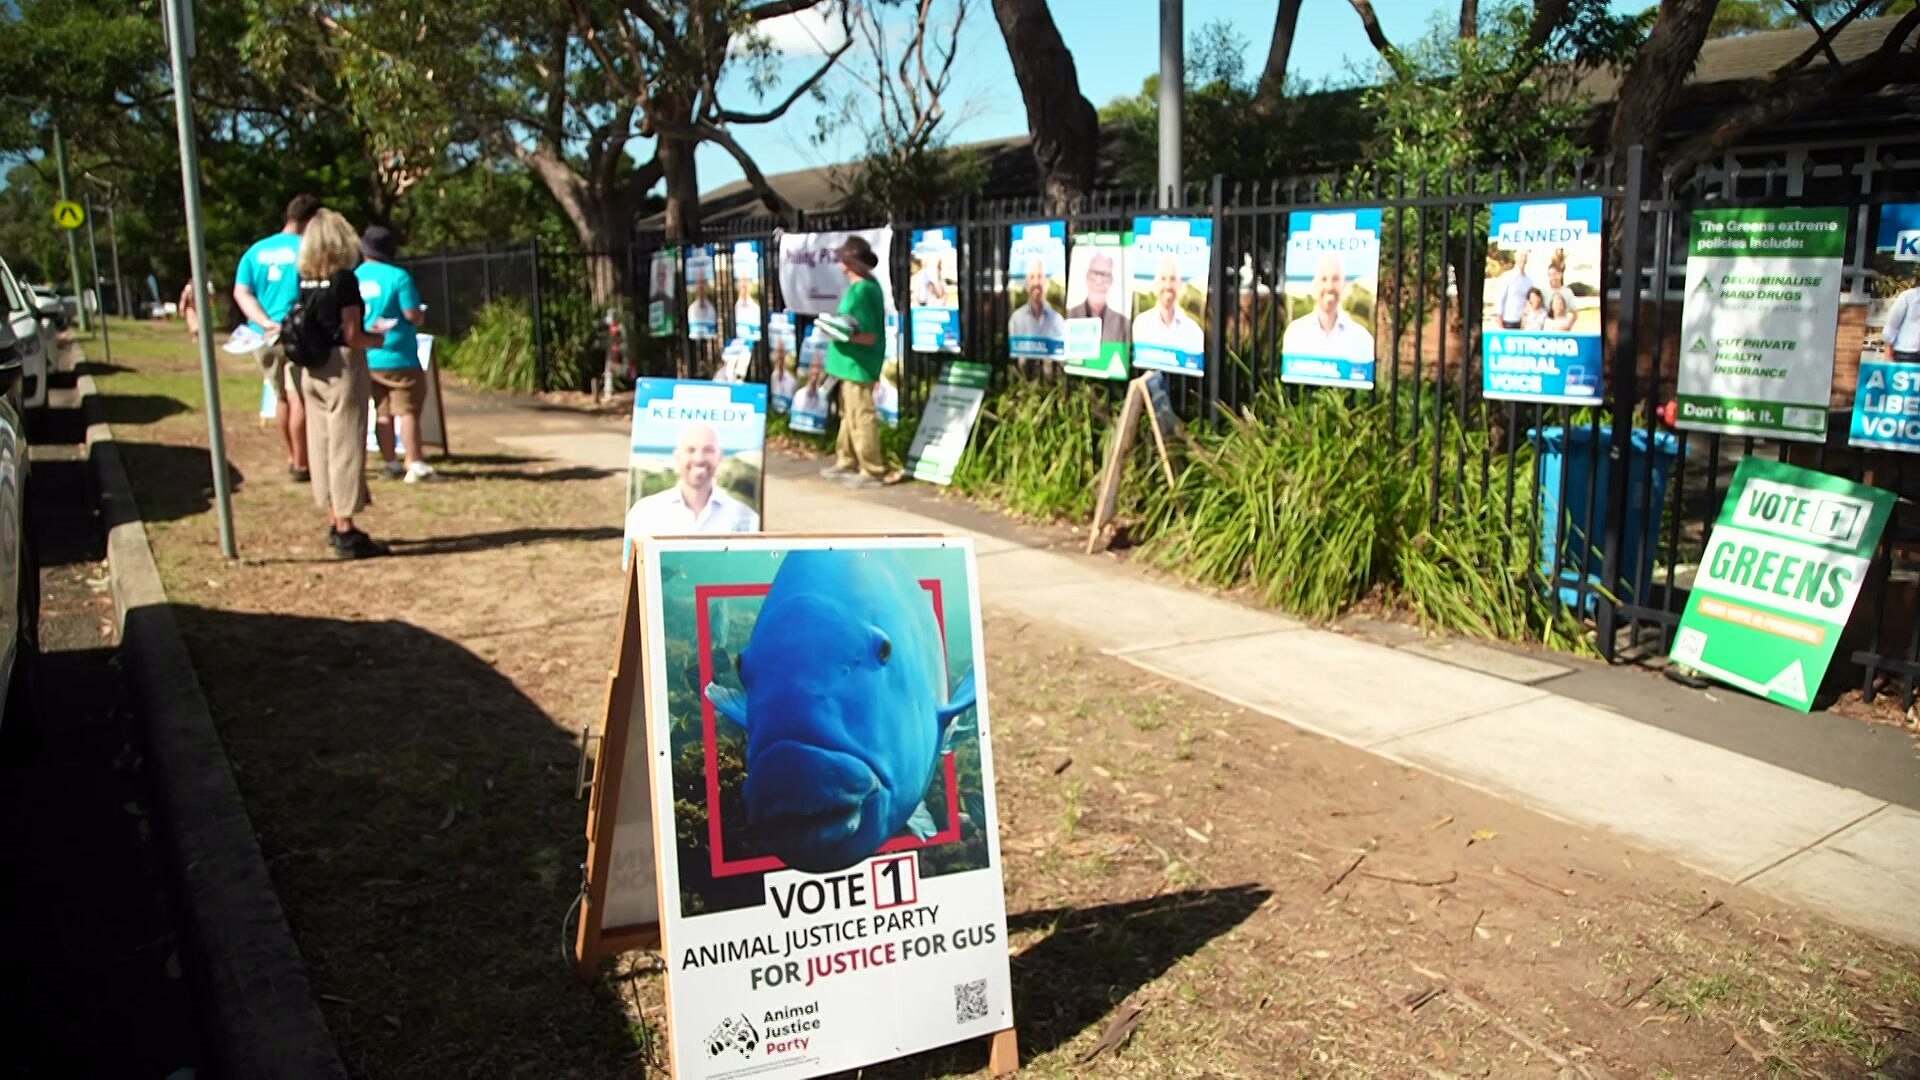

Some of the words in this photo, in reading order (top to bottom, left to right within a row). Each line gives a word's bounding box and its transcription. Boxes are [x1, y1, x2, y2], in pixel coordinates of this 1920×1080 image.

[1502, 227, 1583, 243] KENNEDY
[1699, 219, 1724, 233] The
[1726, 220, 1775, 233] Greens
[1778, 219, 1838, 232] extreme
[1295, 238, 1370, 251] KENNEDY
[1697, 236, 1747, 250] policies
[1749, 237, 1804, 249] include:
[1720, 274, 1822, 287] DECRIMINALISE
[1720, 290, 1754, 300] HARD
[1757, 290, 1804, 301] DRUGS
[1488, 336, 1502, 353] A
[1504, 336, 1578, 357] STRONG
[1716, 338, 1742, 347] CUT
[1743, 339, 1797, 350] PRIVATE
[1489, 354, 1561, 376] LIBERAL
[1715, 352, 1763, 362] HEALTH
[1714, 366, 1788, 378] INSURANCE
[1865, 369, 1885, 389] A
[1489, 372, 1543, 393] VOICE
[652, 406, 749, 422] KENNEDY
[1683, 402, 1723, 419] Don't
[1726, 406, 1756, 422] risk
[1863, 393, 1920, 416] LIBE
[1861, 415, 1920, 440] VOIC
[1748, 489, 1811, 528] VOTE
[1708, 541, 1853, 610] GREENS
[769, 872, 867, 920] VOTE
[881, 859, 905, 906] 1
[682, 934, 781, 972] ANIMAL
[783, 917, 868, 958] JUSTICE
[873, 905, 940, 936] PARTY
[751, 961, 802, 991] FOR
[805, 942, 896, 987] JUSTICE
[902, 933, 948, 962] FOR
[952, 922, 997, 951] GUS
[763, 1000, 820, 1024] Animal
[764, 1019, 821, 1040] Justice
[766, 1037, 810, 1056] Party
